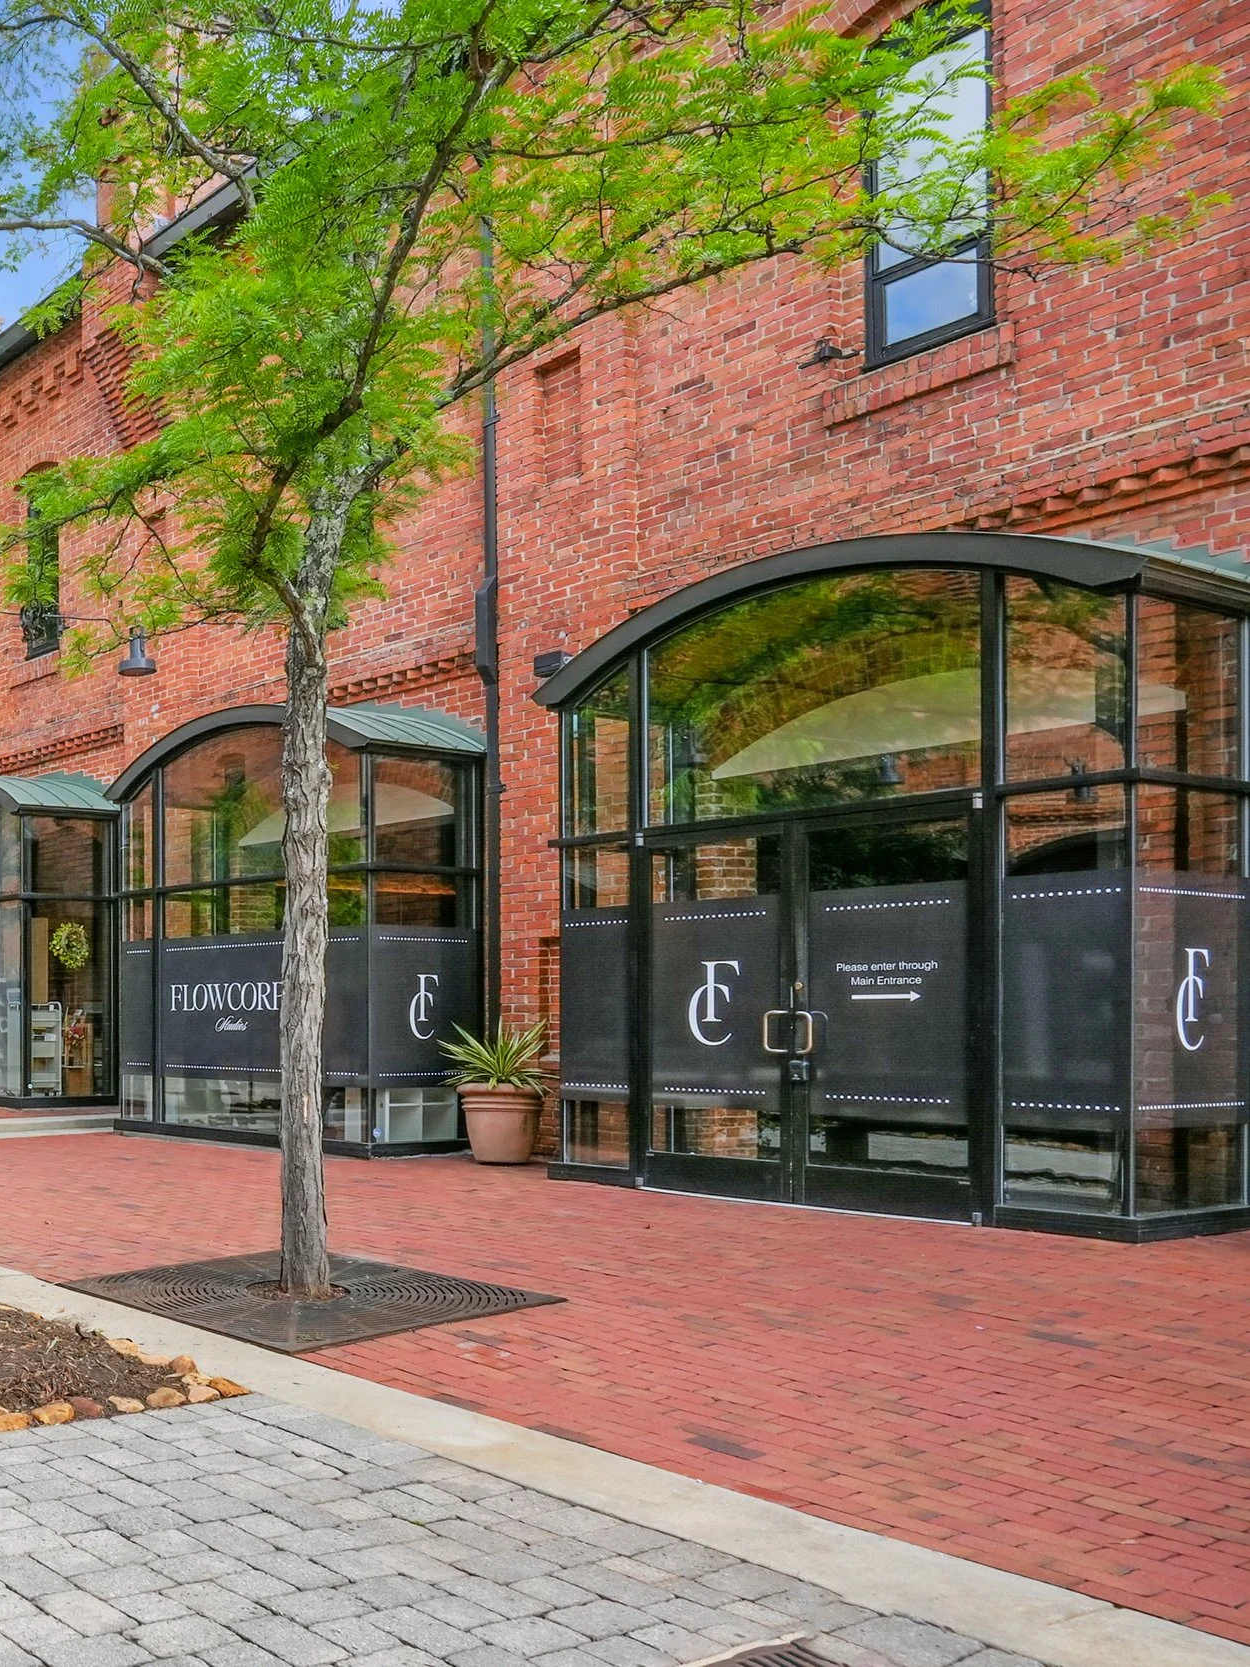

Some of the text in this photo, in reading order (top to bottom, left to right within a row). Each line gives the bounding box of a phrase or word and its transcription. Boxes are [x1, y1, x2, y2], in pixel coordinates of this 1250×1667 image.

[836, 960, 938, 973] Please enter through
[850, 975, 922, 986] Main Entrance
[214, 1015, 249, 1032] Studios
